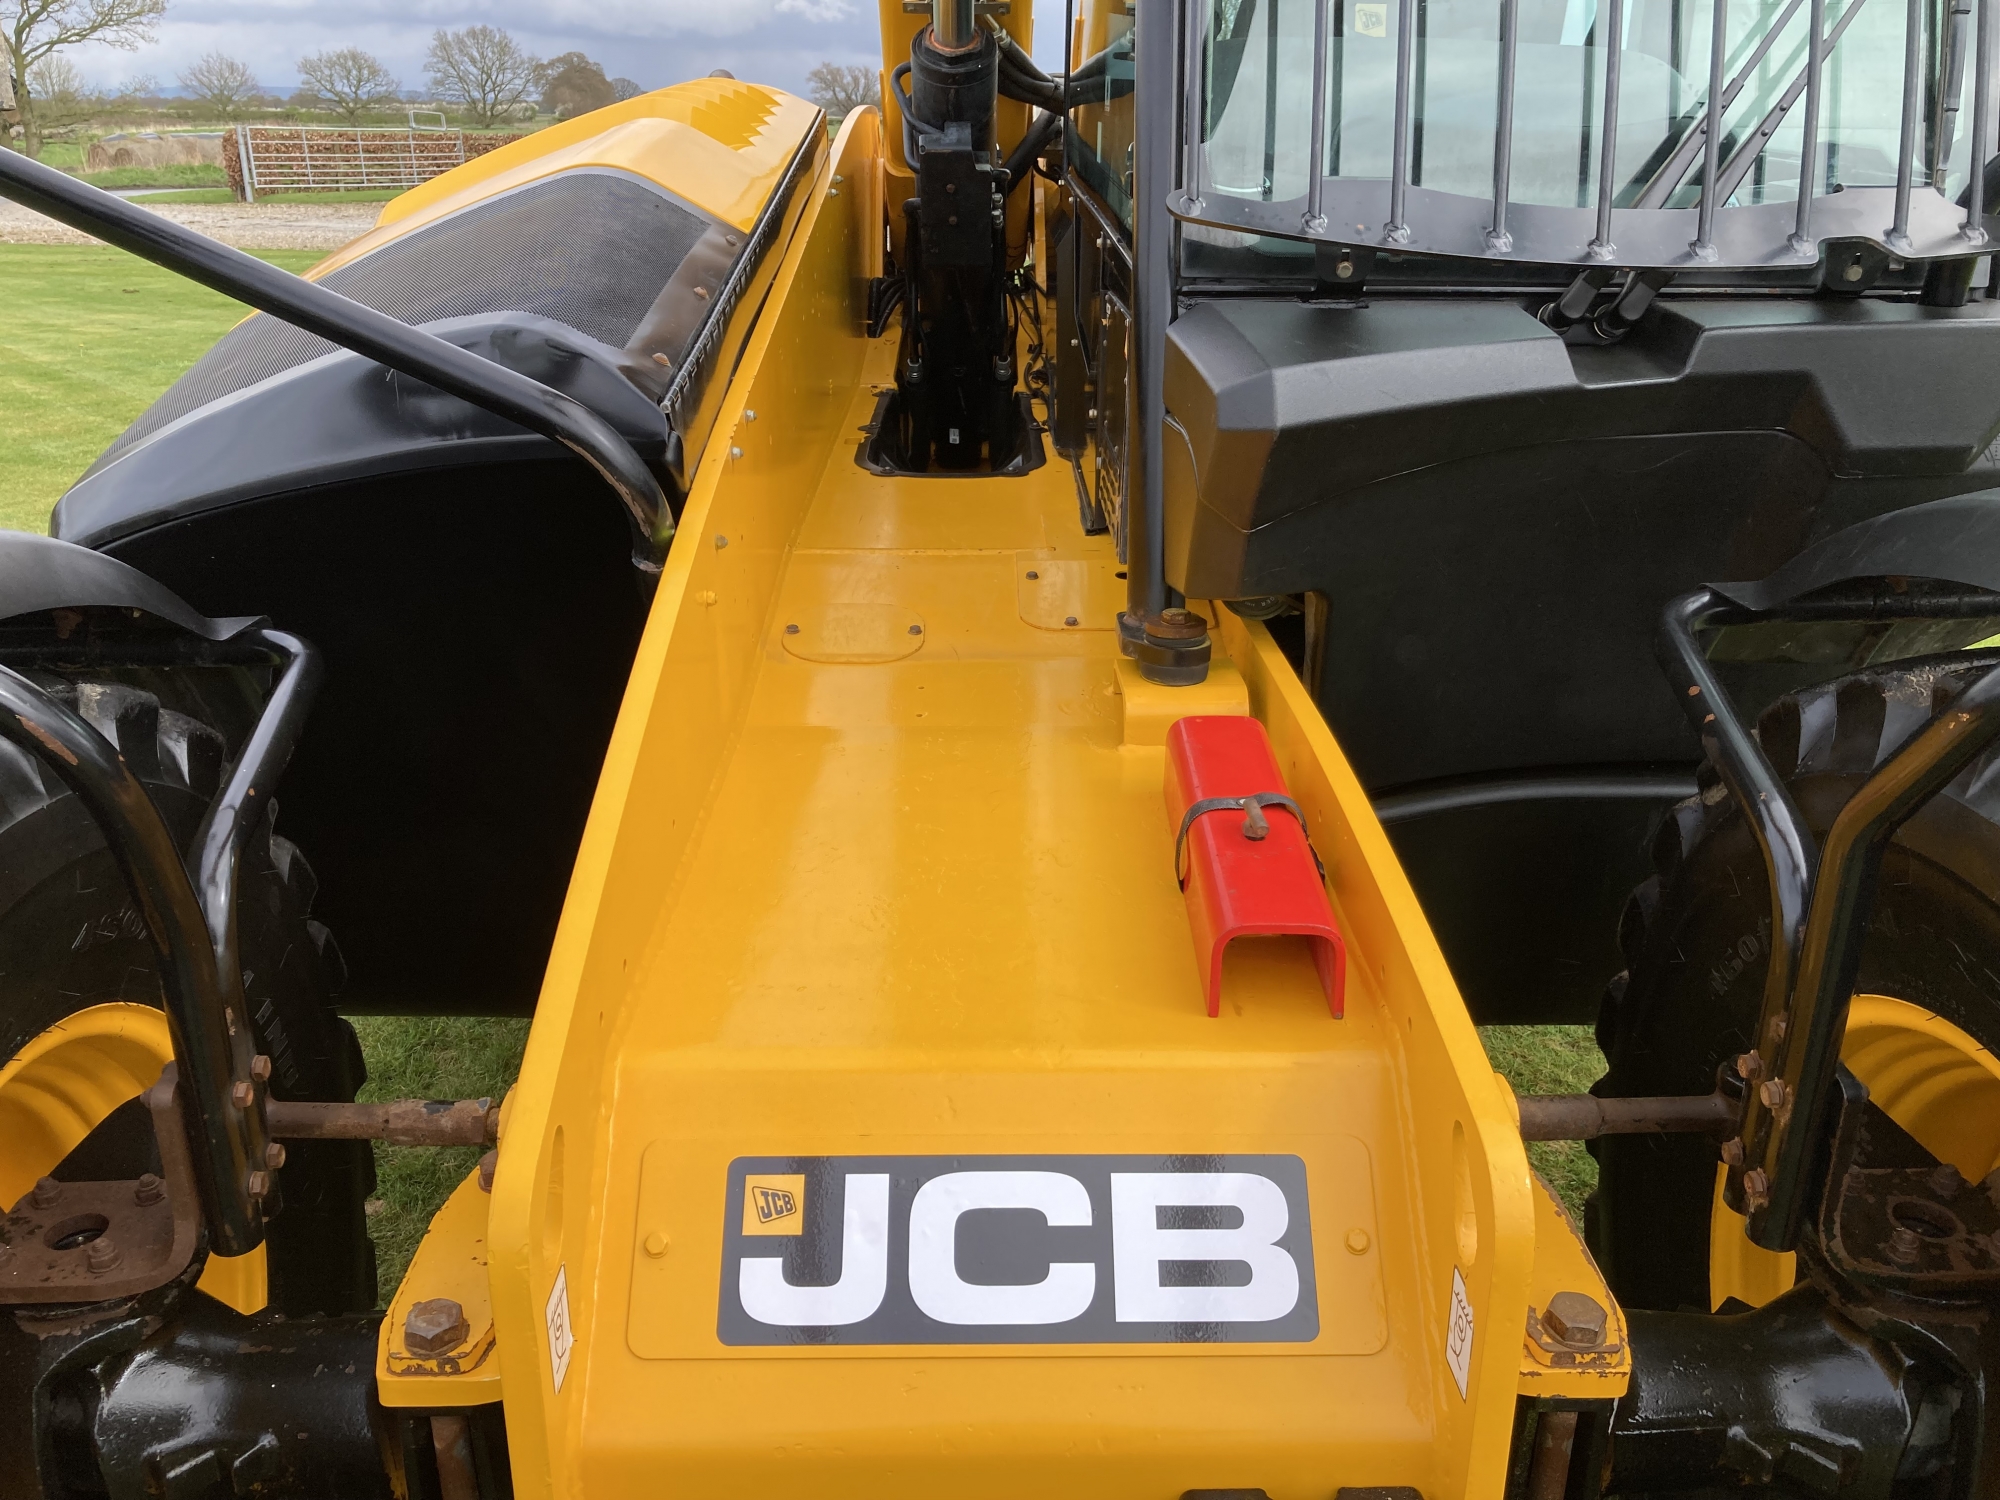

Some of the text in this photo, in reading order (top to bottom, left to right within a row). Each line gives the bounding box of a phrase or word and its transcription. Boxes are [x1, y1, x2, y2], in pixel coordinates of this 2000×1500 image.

[1362, 12, 1383, 28] JCB
[760, 1190, 794, 1220] JCB
[739, 1170, 1299, 1325] JCB
